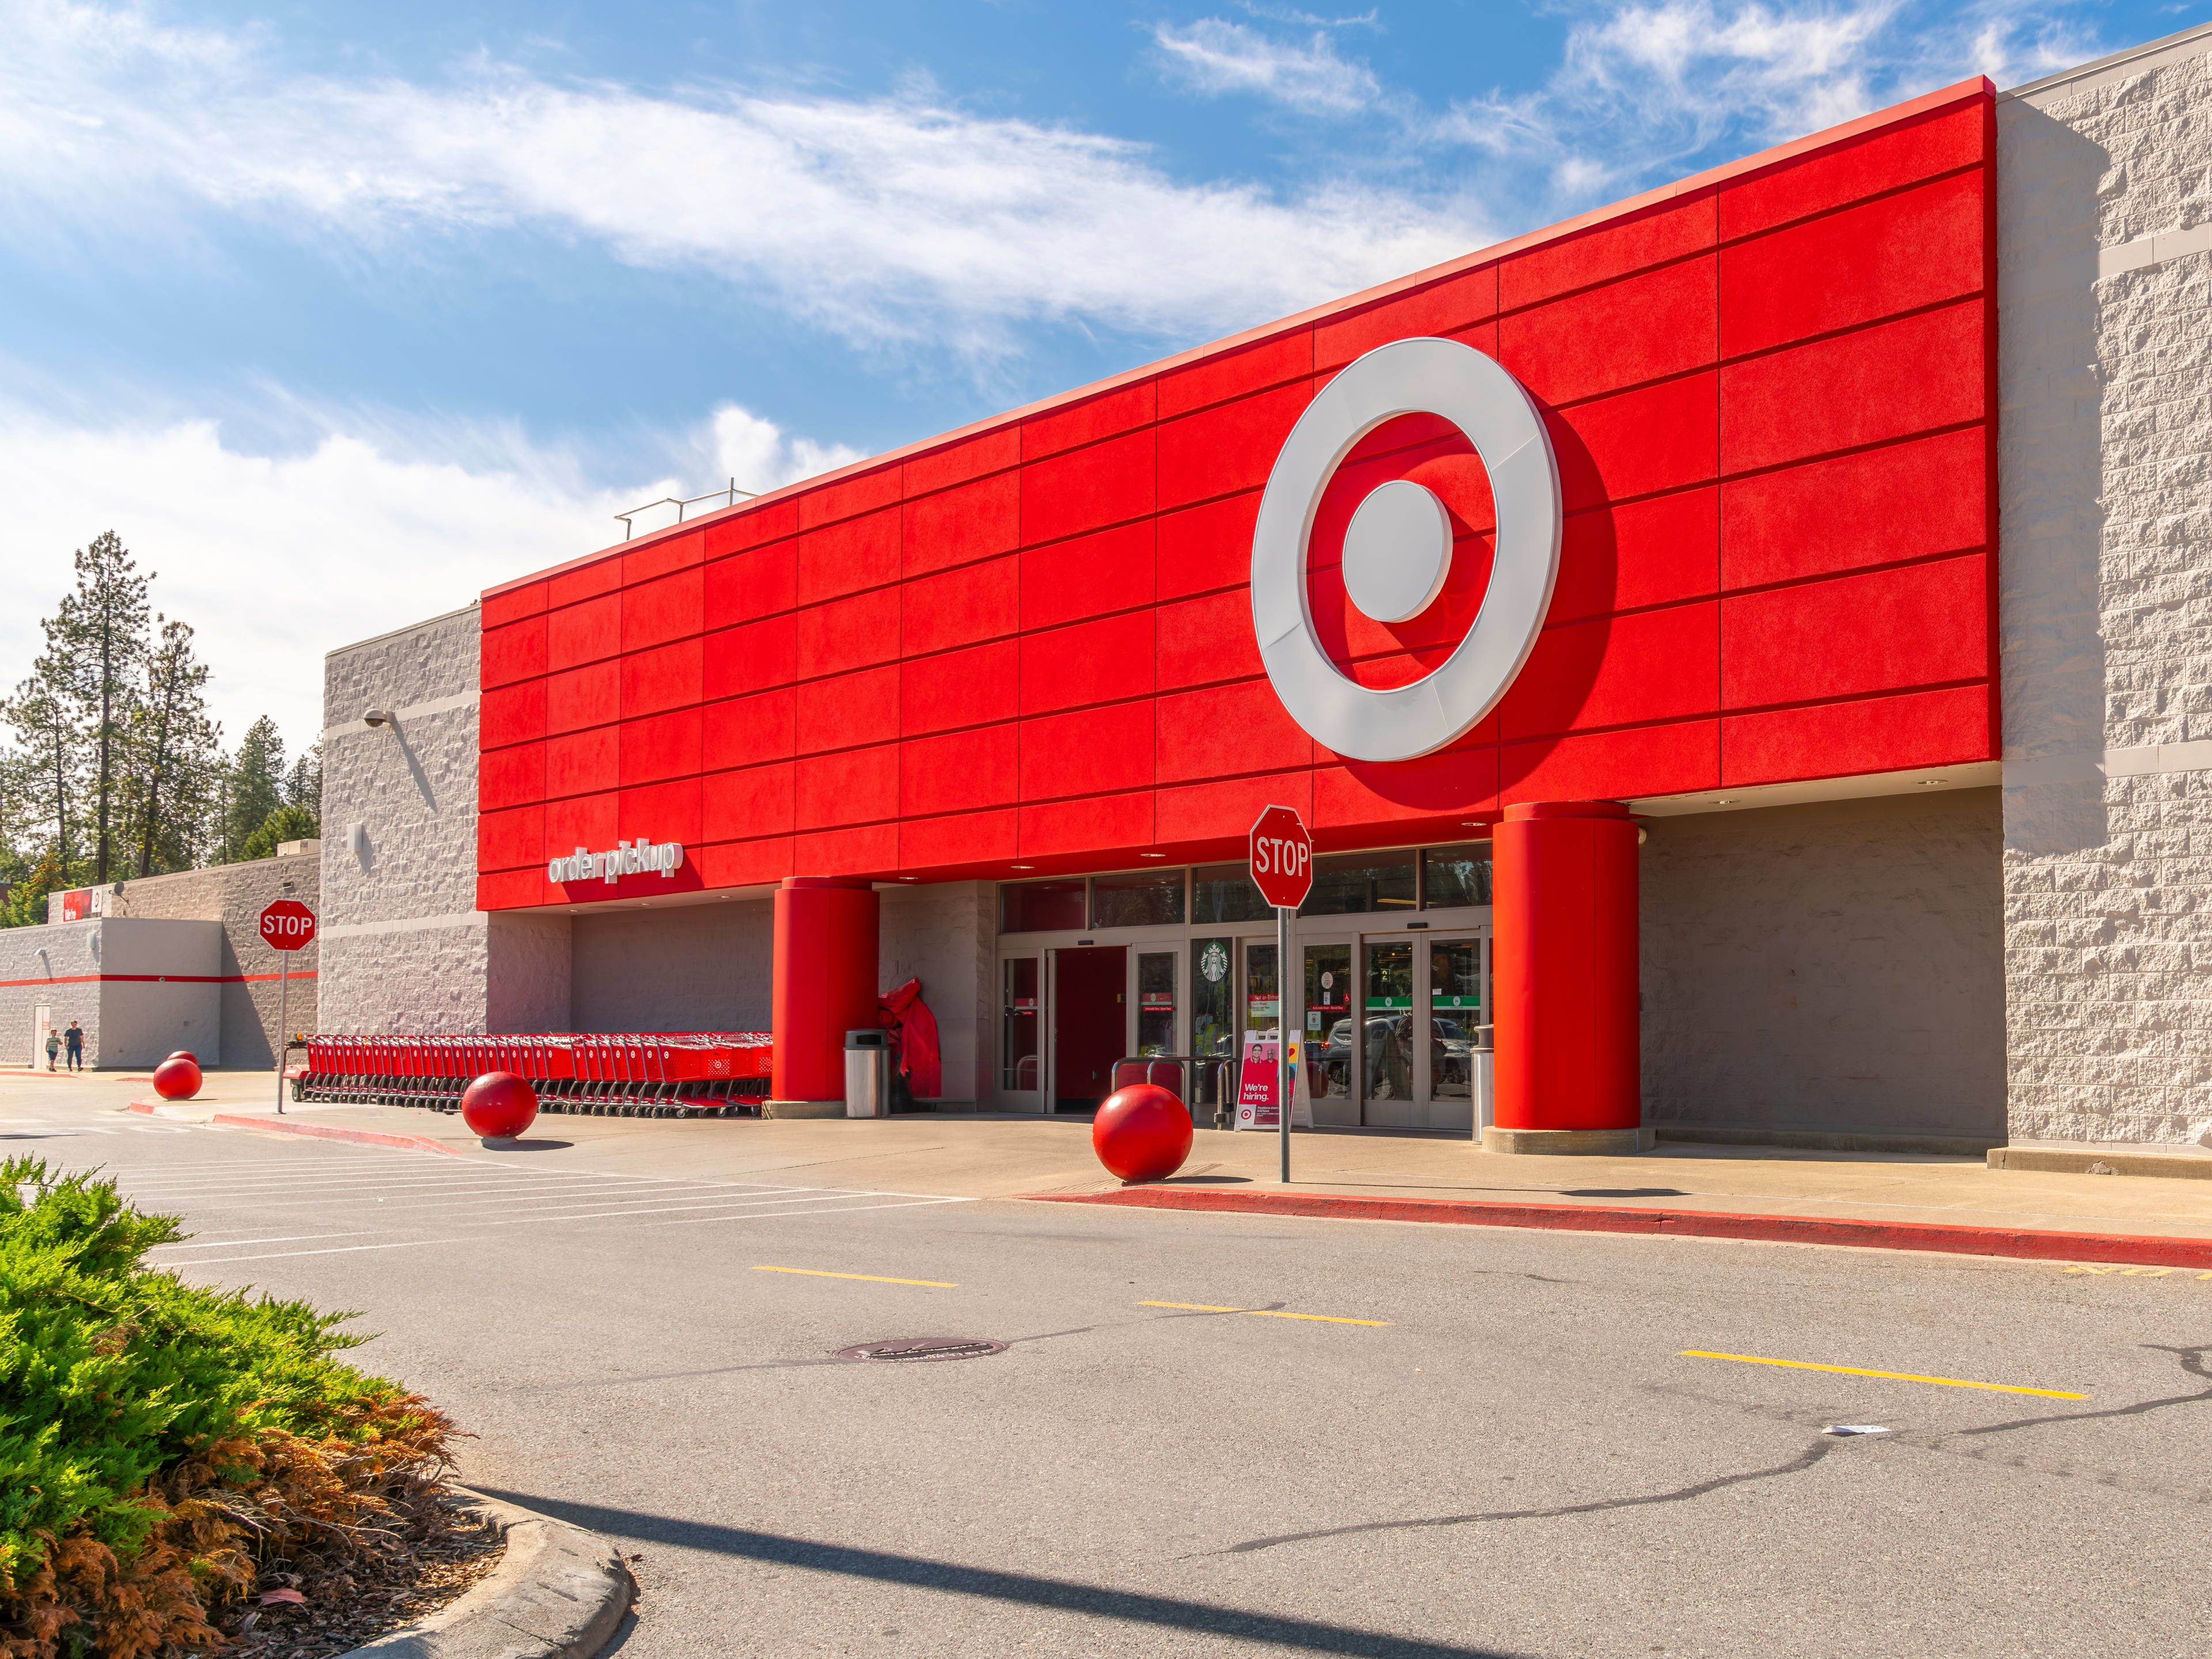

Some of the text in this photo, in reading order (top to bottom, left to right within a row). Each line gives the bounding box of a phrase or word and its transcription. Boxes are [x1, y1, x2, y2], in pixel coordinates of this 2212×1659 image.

[548, 838, 684, 884] order pickup
[1256, 836, 1308, 877] STOP
[65, 908, 77, 921] We're
[263, 915, 313, 935] STOP
[1243, 1092, 1269, 1101] hiring.
